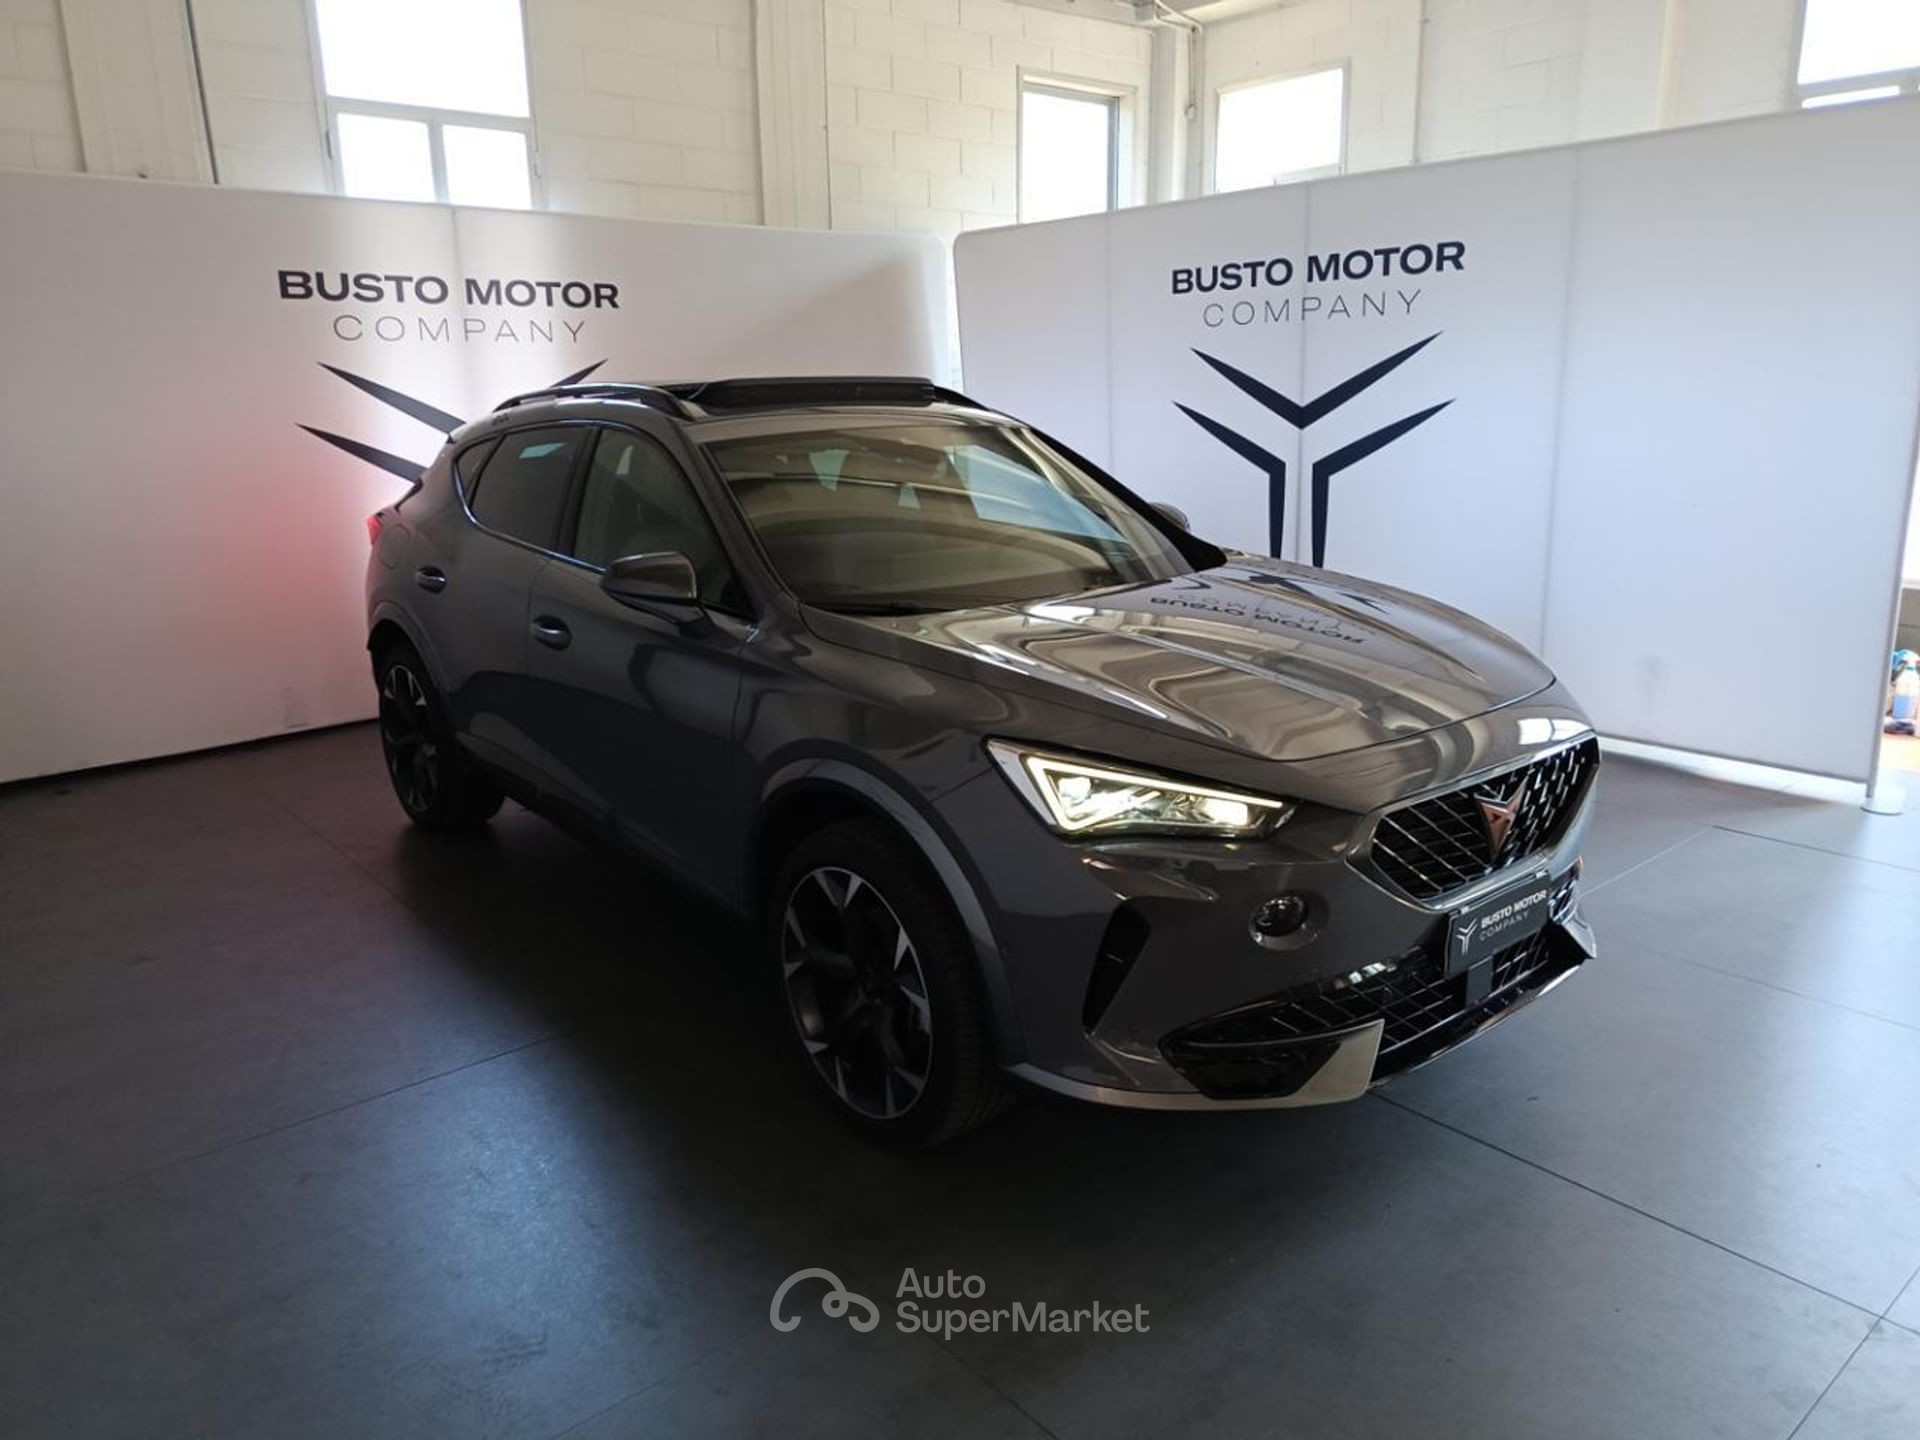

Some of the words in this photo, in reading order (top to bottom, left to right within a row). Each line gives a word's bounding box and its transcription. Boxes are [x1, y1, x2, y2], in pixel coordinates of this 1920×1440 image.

[1171, 257, 1293, 294] BUSTO
[1307, 241, 1465, 283] MOTOR
[278, 270, 448, 304] BUSTO
[465, 278, 620, 309] MOTOR
[1202, 289, 1421, 328] COMPANY
[333, 315, 586, 343] COMPANY
[1479, 910, 1529, 942] COMPANY
[1480, 905, 1512, 929] BUSTO
[1513, 889, 1547, 912] MOTOR
